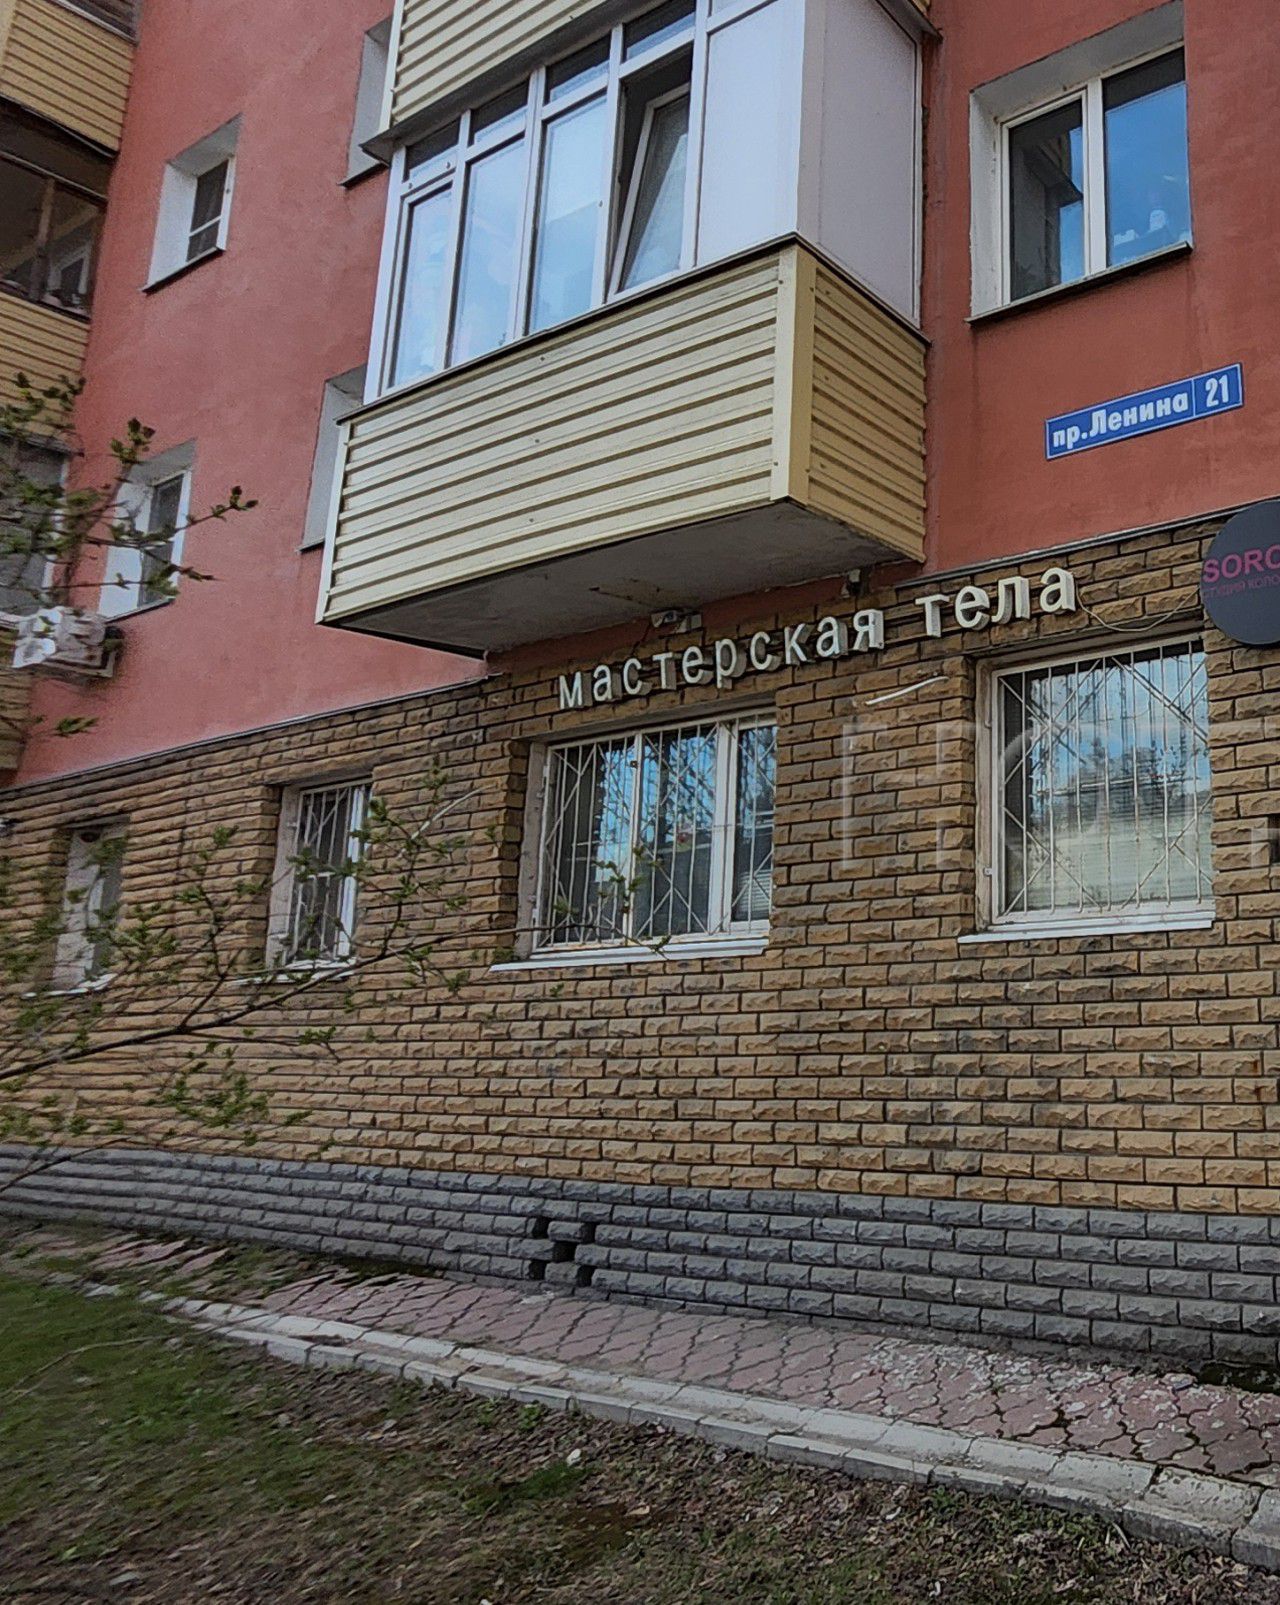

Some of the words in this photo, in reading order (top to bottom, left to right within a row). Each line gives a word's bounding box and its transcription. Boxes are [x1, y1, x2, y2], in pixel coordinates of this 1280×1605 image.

[1205, 374, 1229, 408] 21
[559, 607, 884, 710] мастерская
[915, 567, 1077, 639] тела
